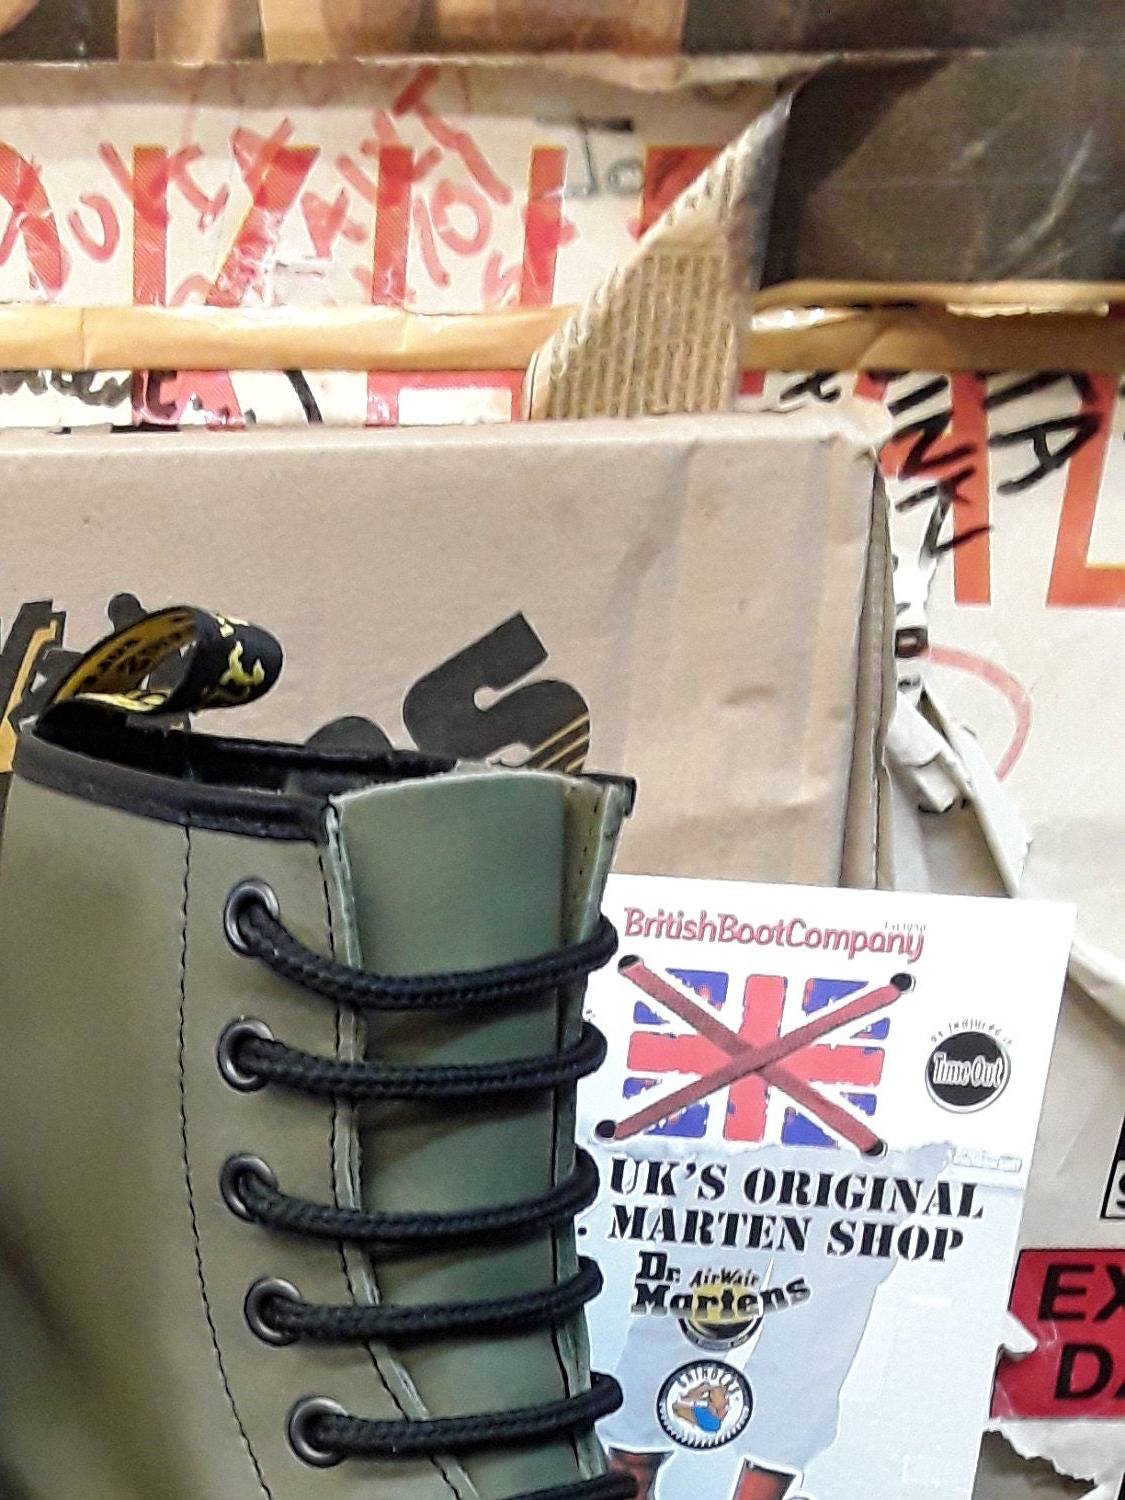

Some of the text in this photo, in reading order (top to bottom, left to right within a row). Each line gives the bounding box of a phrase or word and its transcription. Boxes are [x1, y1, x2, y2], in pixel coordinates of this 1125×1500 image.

[624, 906, 926, 963] BritishBootCompany
[610, 1157, 985, 1219] UK'S ORIGINAL
[607, 1204, 965, 1262] MARTEN SHOP
[631, 1276, 811, 1317] Martens
[1055, 1342, 1125, 1401] D
